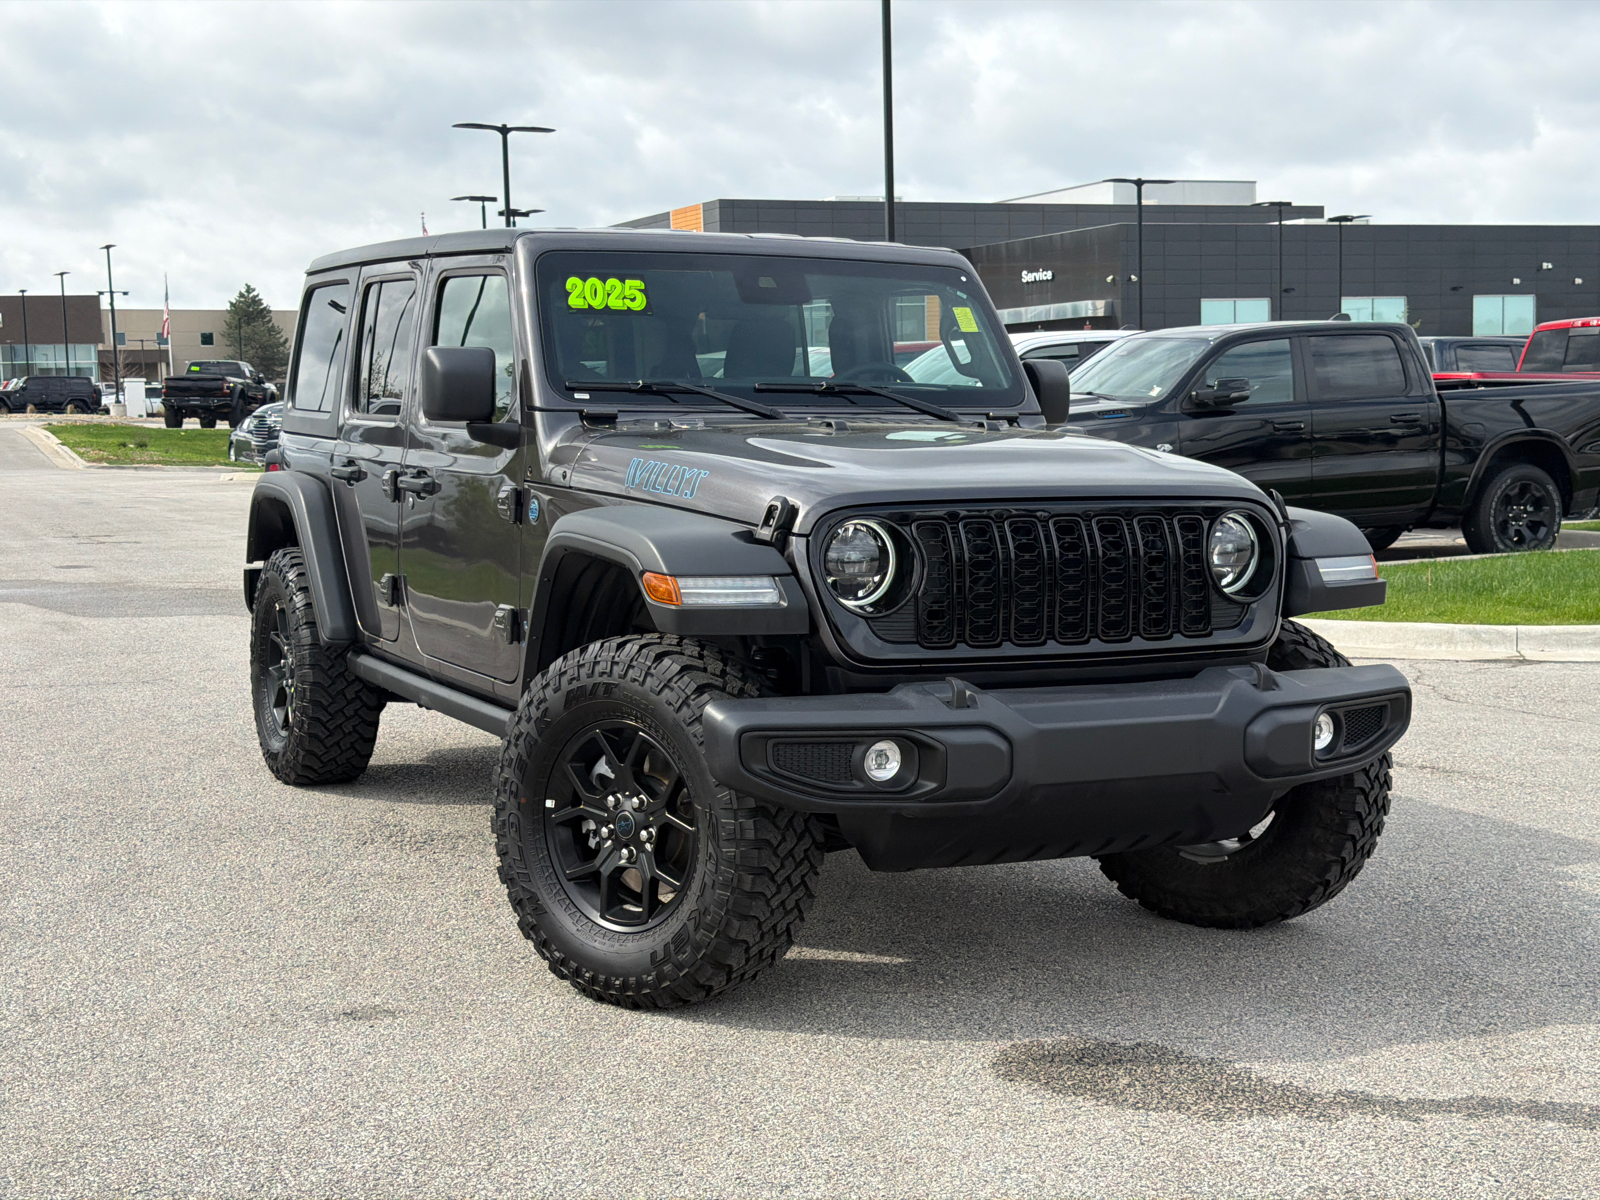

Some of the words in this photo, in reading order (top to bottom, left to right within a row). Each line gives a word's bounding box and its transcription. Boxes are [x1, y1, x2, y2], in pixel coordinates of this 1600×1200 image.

[1021, 268, 1053, 283] Service
[565, 276, 647, 311] 2025
[624, 457, 710, 500] WILLYS
